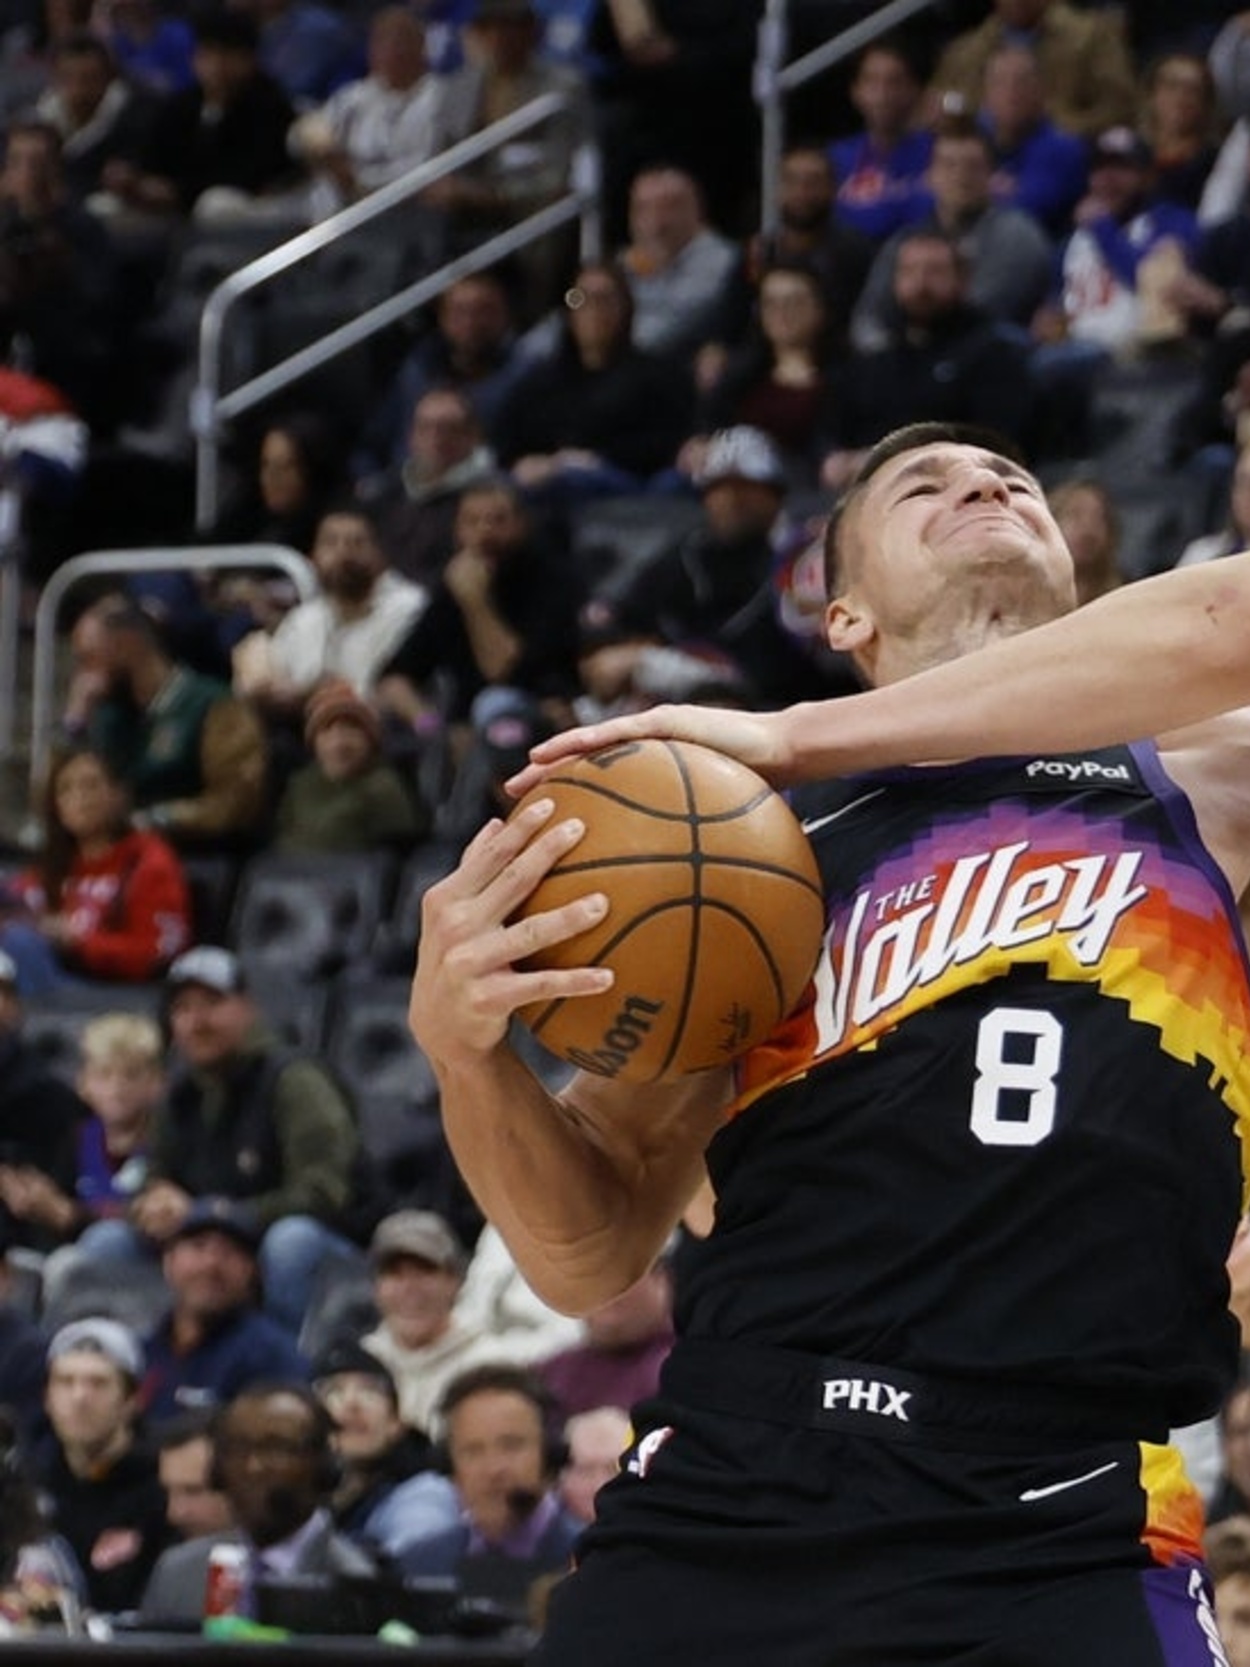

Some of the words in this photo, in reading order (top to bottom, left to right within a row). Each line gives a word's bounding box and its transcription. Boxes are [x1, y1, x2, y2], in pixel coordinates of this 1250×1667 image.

[1026, 760, 1130, 782] PayPal
[876, 875, 937, 921] THE
[813, 840, 1148, 1058] Valley
[566, 994, 665, 1080] lson
[970, 1006, 1063, 1146] 8
[823, 1379, 912, 1422] PHX
